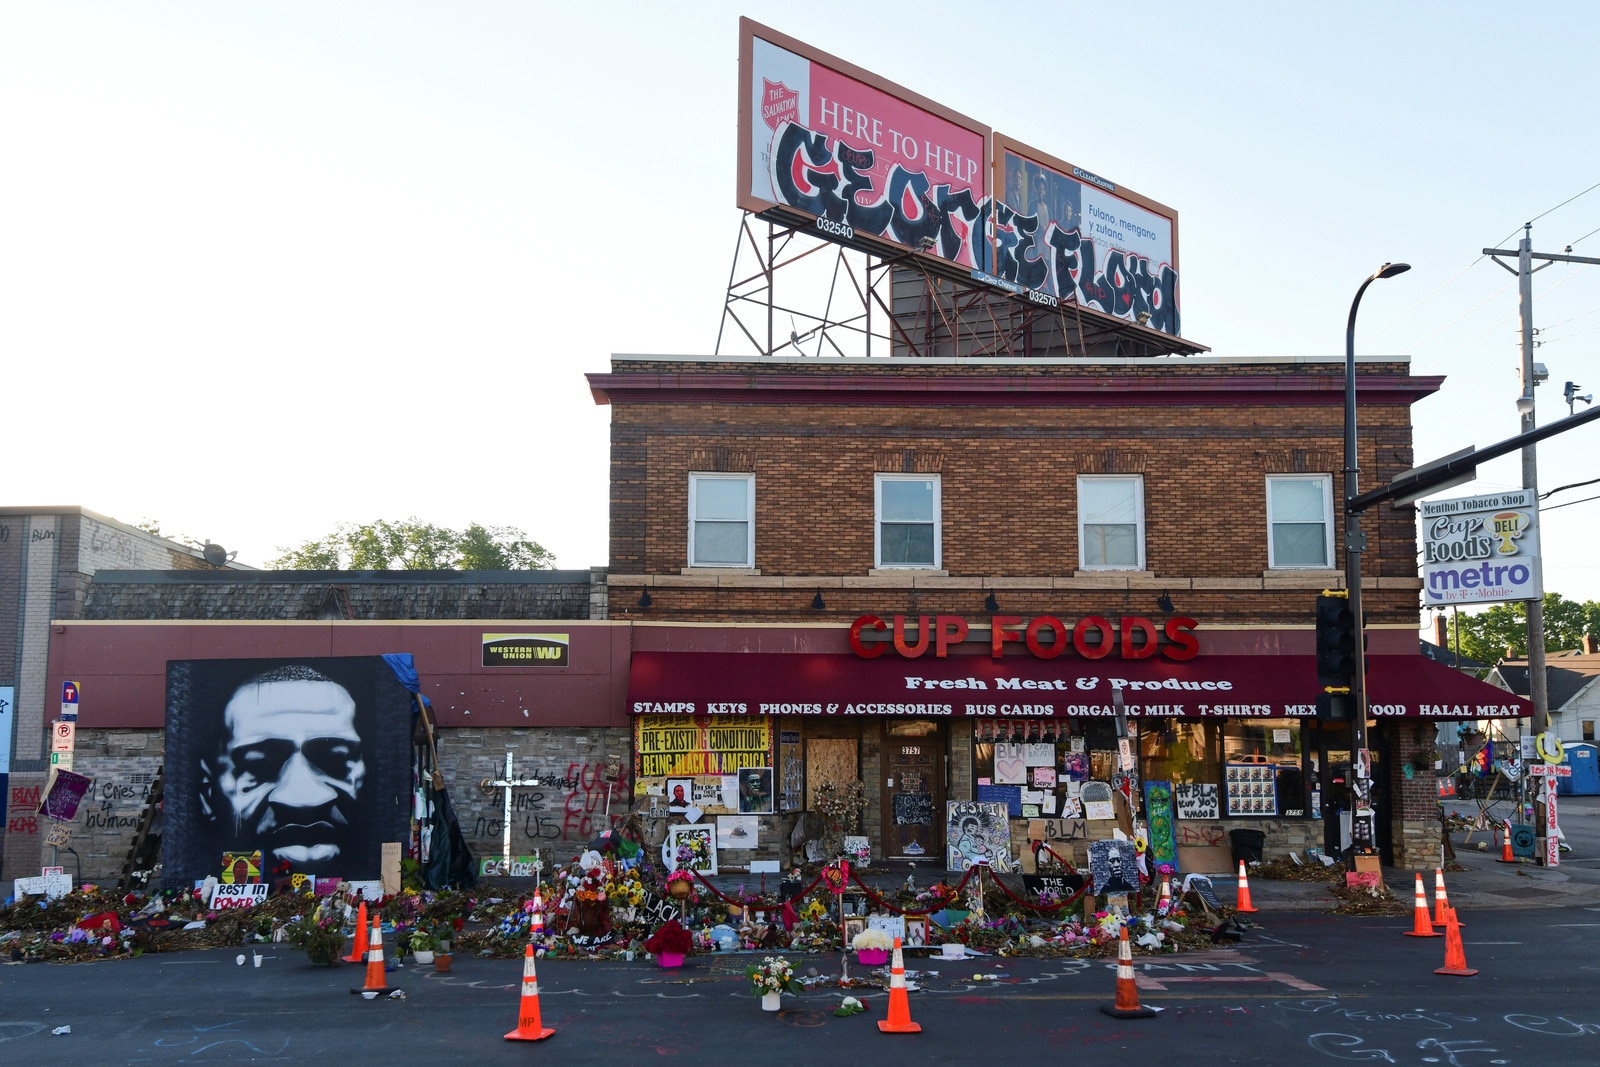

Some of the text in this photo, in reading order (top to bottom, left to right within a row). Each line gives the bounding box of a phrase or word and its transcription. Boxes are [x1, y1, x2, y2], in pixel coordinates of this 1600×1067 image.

[769, 87, 784, 101] THE
[763, 96, 796, 119] SALVATION
[819, 96, 883, 147] HERE
[888, 129, 918, 160] TO
[924, 140, 978, 184] HELP
[816, 217, 854, 239] 032540
[1089, 204, 1156, 241] Fulano, mengano
[1089, 220, 1125, 242] y zutana.
[985, 275, 1017, 292] Clear Channel
[1029, 290, 1058, 307] 032570
[1424, 494, 1525, 515] Menthol Tobacco Shop
[1430, 516, 1484, 542] Cup
[1494, 519, 1519, 533] DELI
[1424, 537, 1490, 561] Foods
[1429, 562, 1530, 590] metro
[1446, 591, 1457, 600] by
[850, 614, 1200, 661] CUP FOODS
[904, 677, 1233, 691] Fresh Meat & Produce
[633, 702, 695, 714] STAMPS
[707, 703, 747, 714] KEYS
[760, 703, 952, 715] PHONES & ACCESSORIES
[965, 704, 1054, 715] BUS CARDS
[1145, 705, 1185, 716] MILK
[1198, 704, 1271, 716] T-SHIRTS
[1368, 704, 1406, 716] OOD
[1419, 704, 1521, 716] HALAL MEAT
[643, 729, 765, 751] PRE-EXISTING CONDITION:
[902, 746, 920, 754] 3757
[996, 744, 1026, 758] BLM
[643, 753, 672, 775] BEING
[675, 752, 706, 774] BLACK
[708, 752, 719, 773] IN
[721, 752, 765, 774] AMERICA
[12, 785, 41, 804] BLM
[1176, 784, 1218, 798] #BLM
[565, 791, 622, 816] CUP
[1547, 792, 1557, 830] George
[949, 801, 987, 822] REST
[989, 802, 1009, 825] IN
[8, 816, 38, 834] ACAB
[1047, 820, 1087, 838] BLM
[948, 844, 1011, 873] POER
[1547, 835, 1559, 865] Floyd
[1033, 886, 1075, 895] WORLD
[1040, 878, 1063, 886] THE
[572, 930, 612, 945] WE ARE
